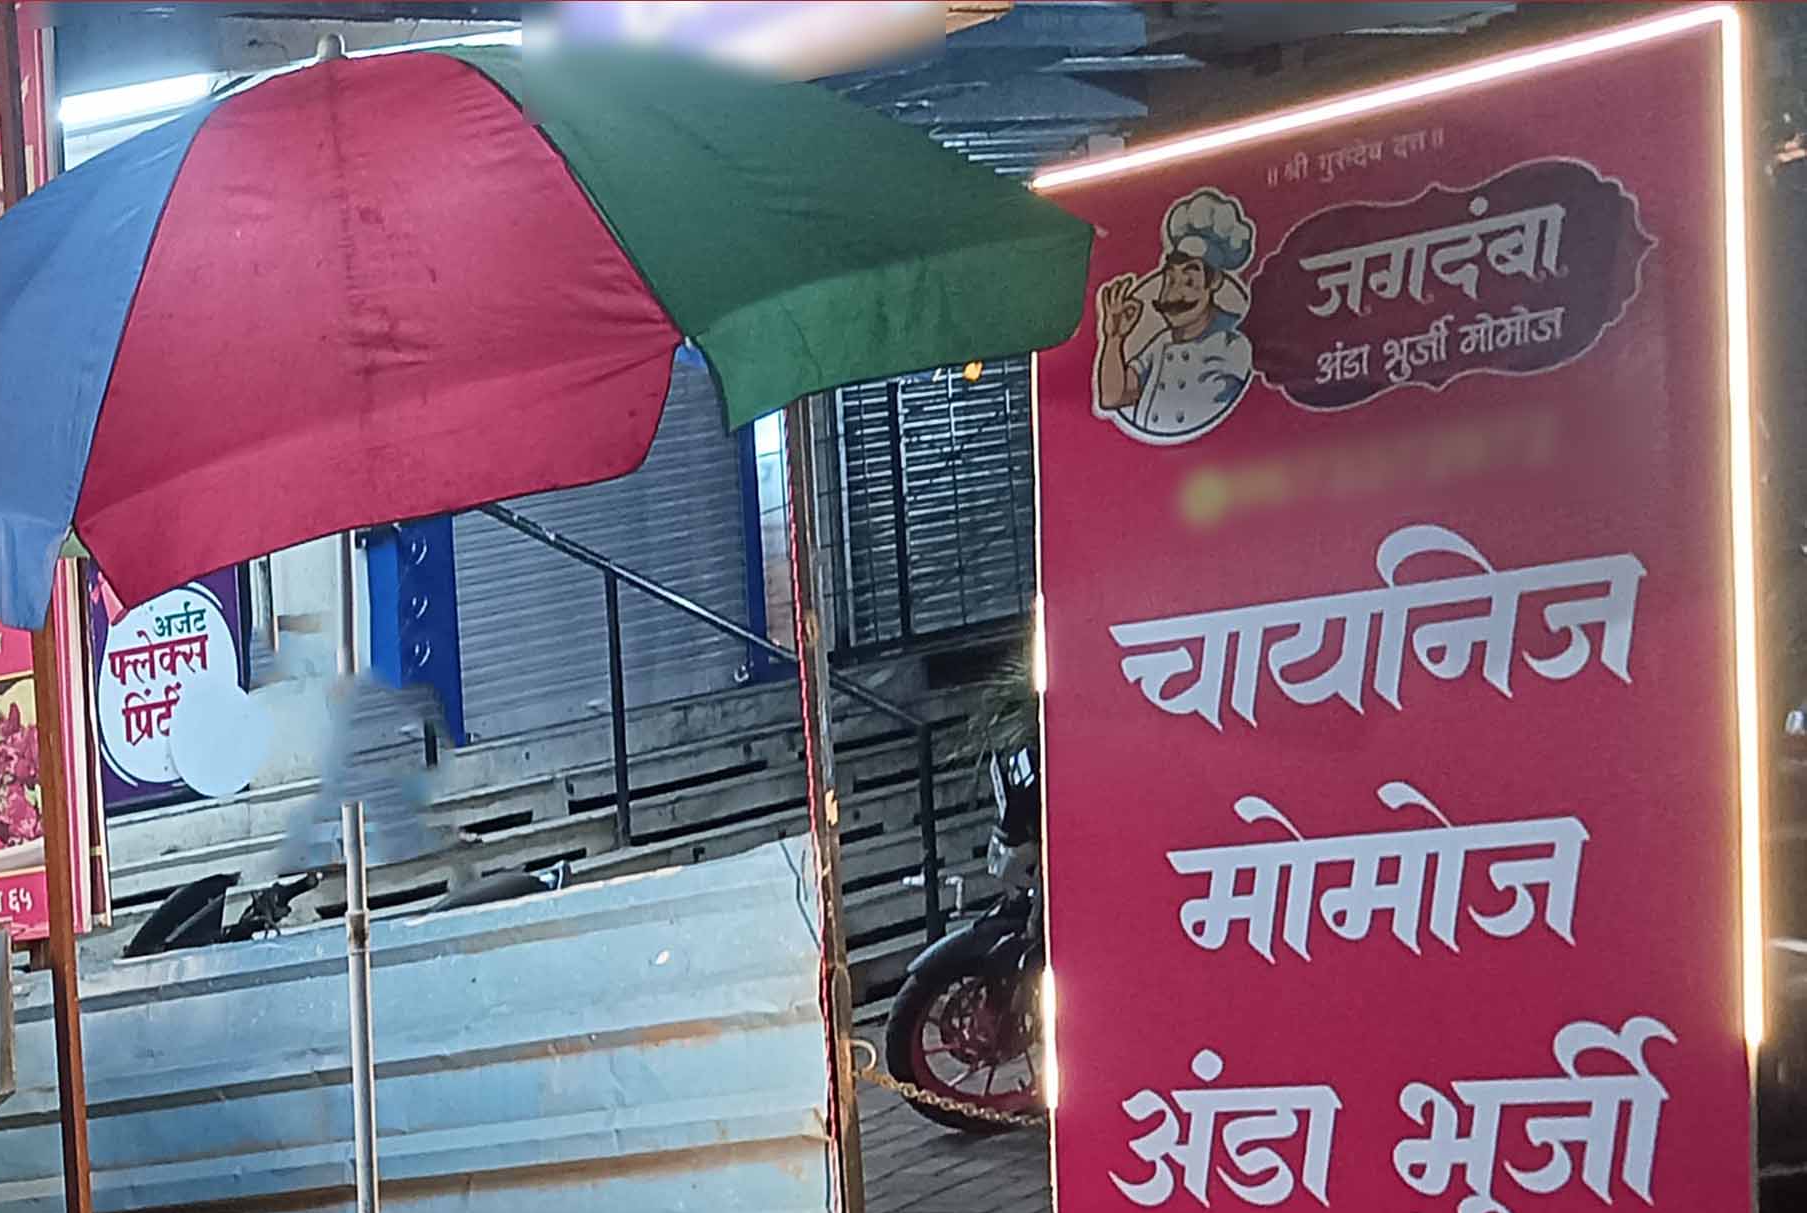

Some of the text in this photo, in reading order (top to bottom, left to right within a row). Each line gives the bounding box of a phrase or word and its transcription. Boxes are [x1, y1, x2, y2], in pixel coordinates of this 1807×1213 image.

[1299, 196, 1568, 317] जगदंबा
[1315, 305, 1566, 385] अंडा भुर्जी मोमोज
[1108, 523, 1647, 732] चायनिज
[1165, 781, 1591, 965] मोमोज
[1107, 1048, 1343, 1209] अंडा
